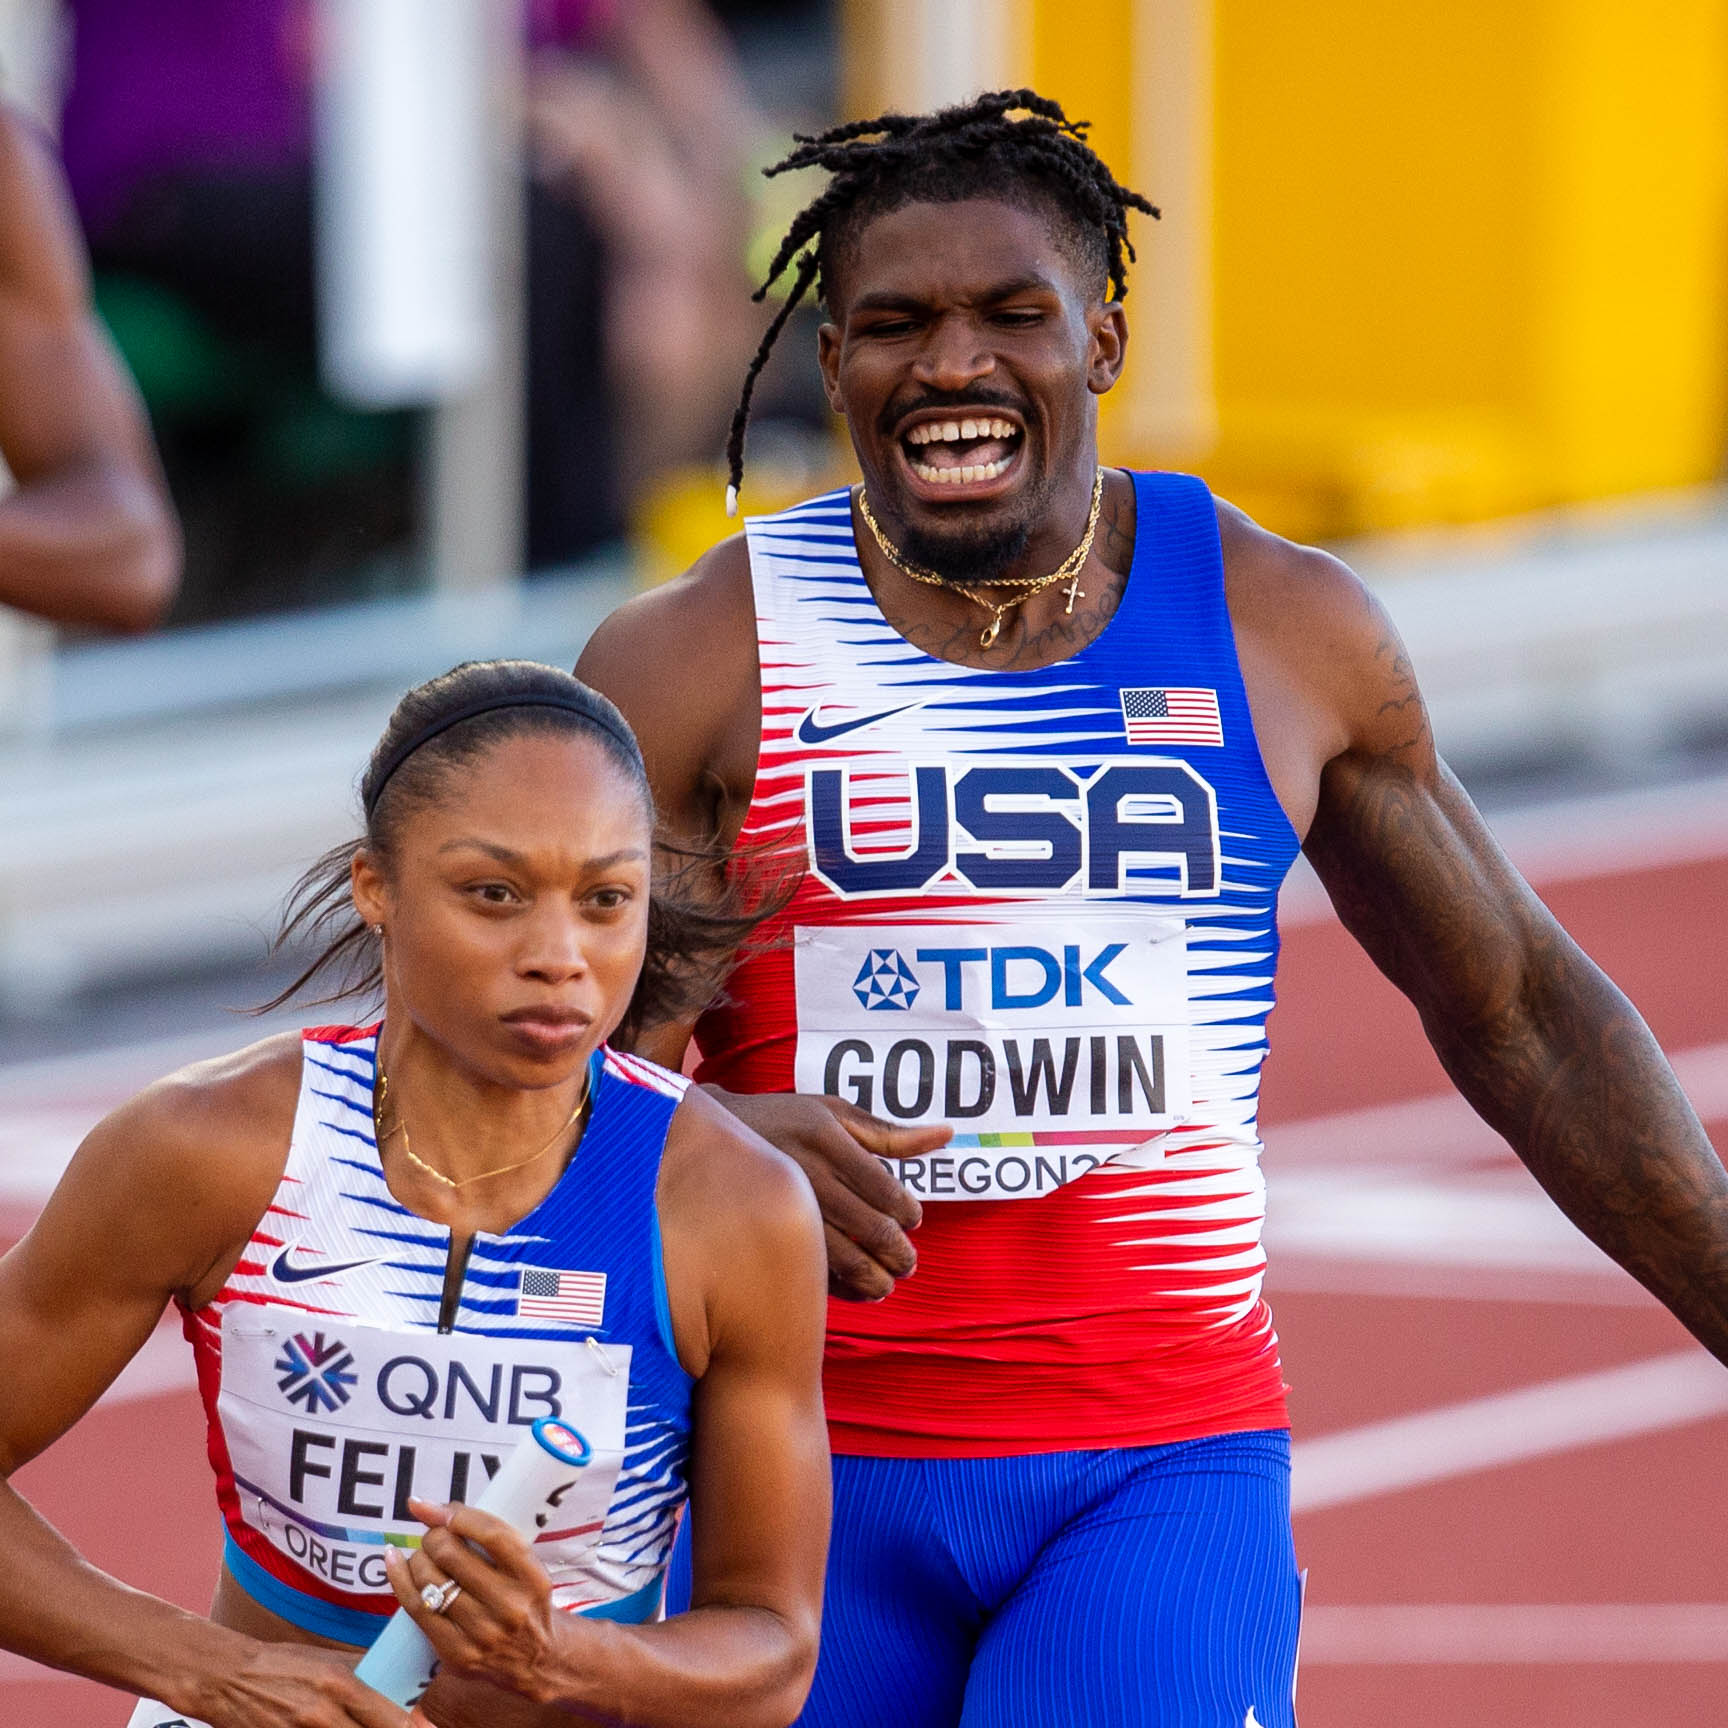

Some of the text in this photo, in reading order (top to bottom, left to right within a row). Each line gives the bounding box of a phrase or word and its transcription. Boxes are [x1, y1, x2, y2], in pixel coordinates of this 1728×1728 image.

[804, 759, 1221, 900] USA
[917, 942, 1134, 1010] TDK
[823, 1034, 1166, 1119] GODWIN
[376, 1355, 564, 1426] QNB
[289, 1428, 503, 1524] FELI
